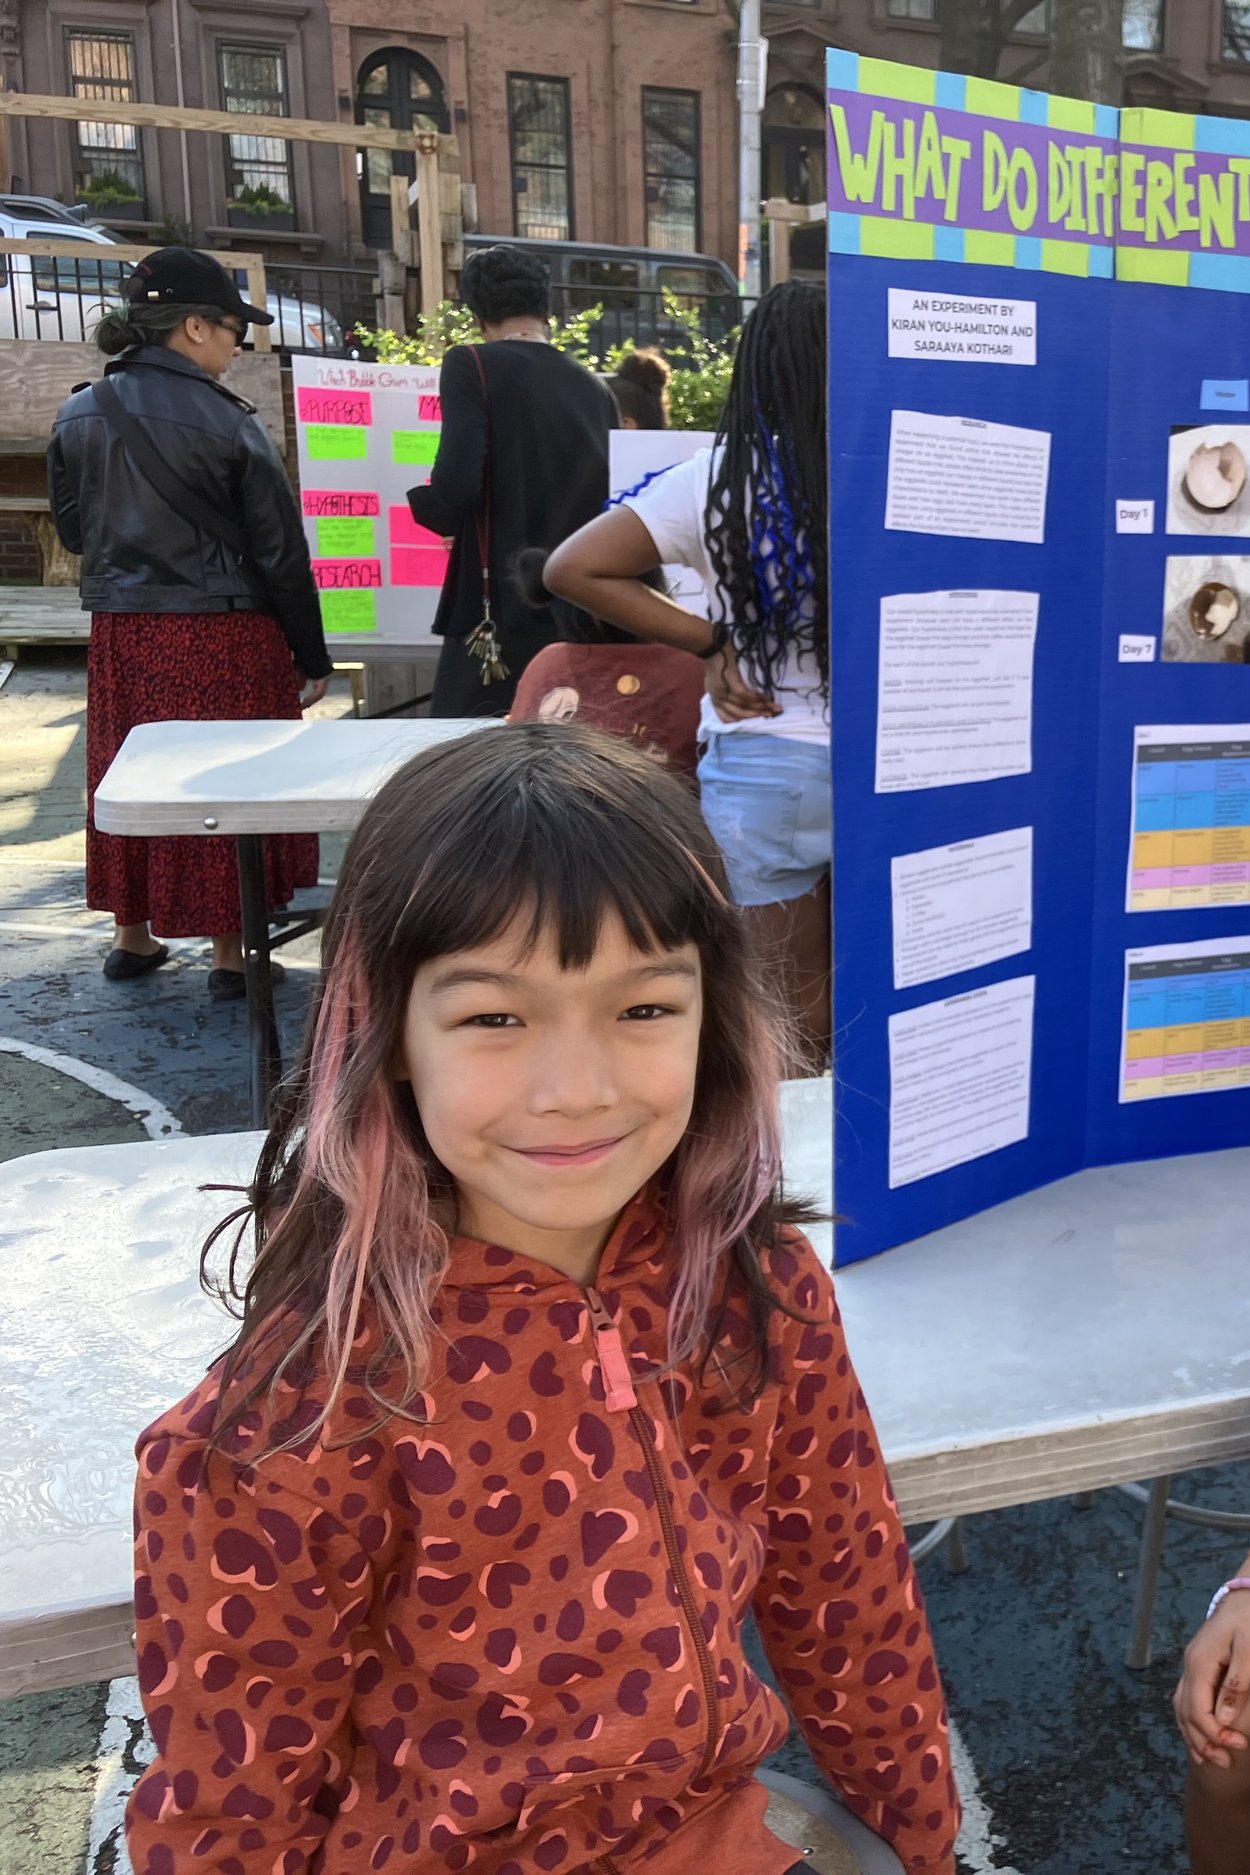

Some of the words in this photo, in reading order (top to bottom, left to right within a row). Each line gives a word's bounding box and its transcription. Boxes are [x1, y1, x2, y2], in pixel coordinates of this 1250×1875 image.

[830, 103, 970, 221] WHAT
[983, 130, 1037, 231] DO
[912, 299, 929, 312] AN
[932, 300, 998, 316] EXPERIMENT
[1000, 305, 1015, 316] BY
[891, 319, 926, 331] KIRAN
[928, 321, 1009, 336] YOU-HAMILTON
[1011, 326, 1034, 337] AND
[914, 340, 965, 354] SARAAYA
[967, 343, 1013, 355] KOTHARI
[307, 494, 380, 517] HYPOTHESIS
[1119, 509, 1141, 521] Day
[1142, 508, 1149, 518] 1
[1122, 644, 1143, 657] Day
[1145, 644, 1153, 654] 7
